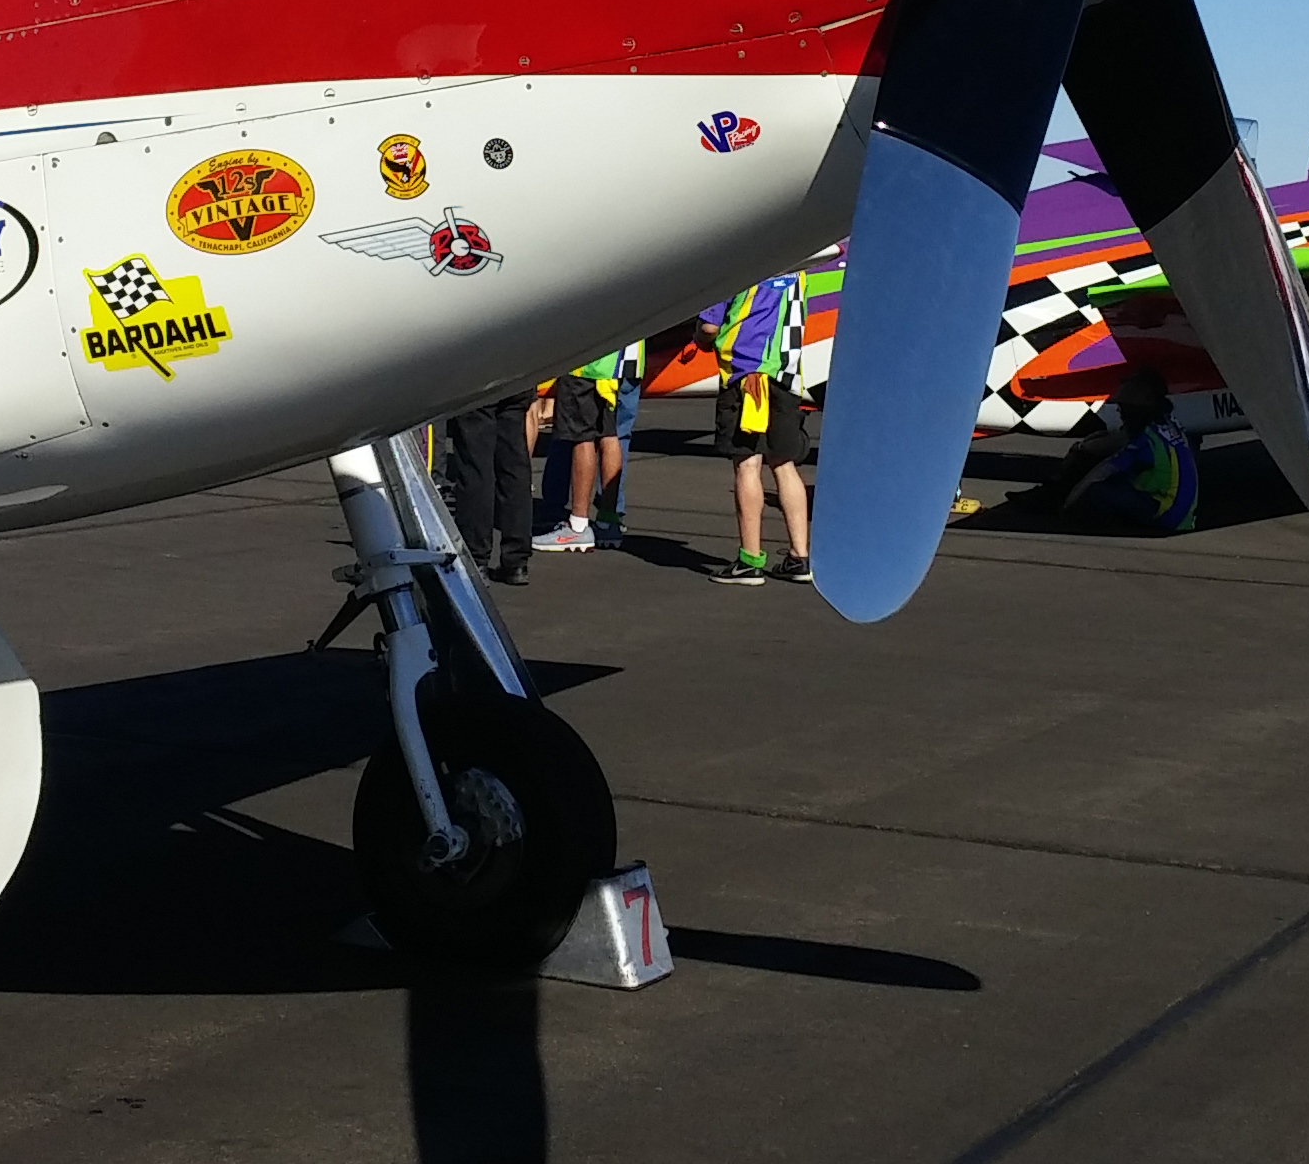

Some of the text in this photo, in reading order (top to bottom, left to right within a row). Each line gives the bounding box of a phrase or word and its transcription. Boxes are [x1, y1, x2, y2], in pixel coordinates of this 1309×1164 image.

[697, 111, 738, 153] VP
[209, 152, 259, 172] Engine by
[191, 194, 291, 226] VINTAGE
[246, 226, 292, 249] CALIFORNIA
[86, 312, 227, 359] BARDAHL
[622, 884, 653, 966] 7
